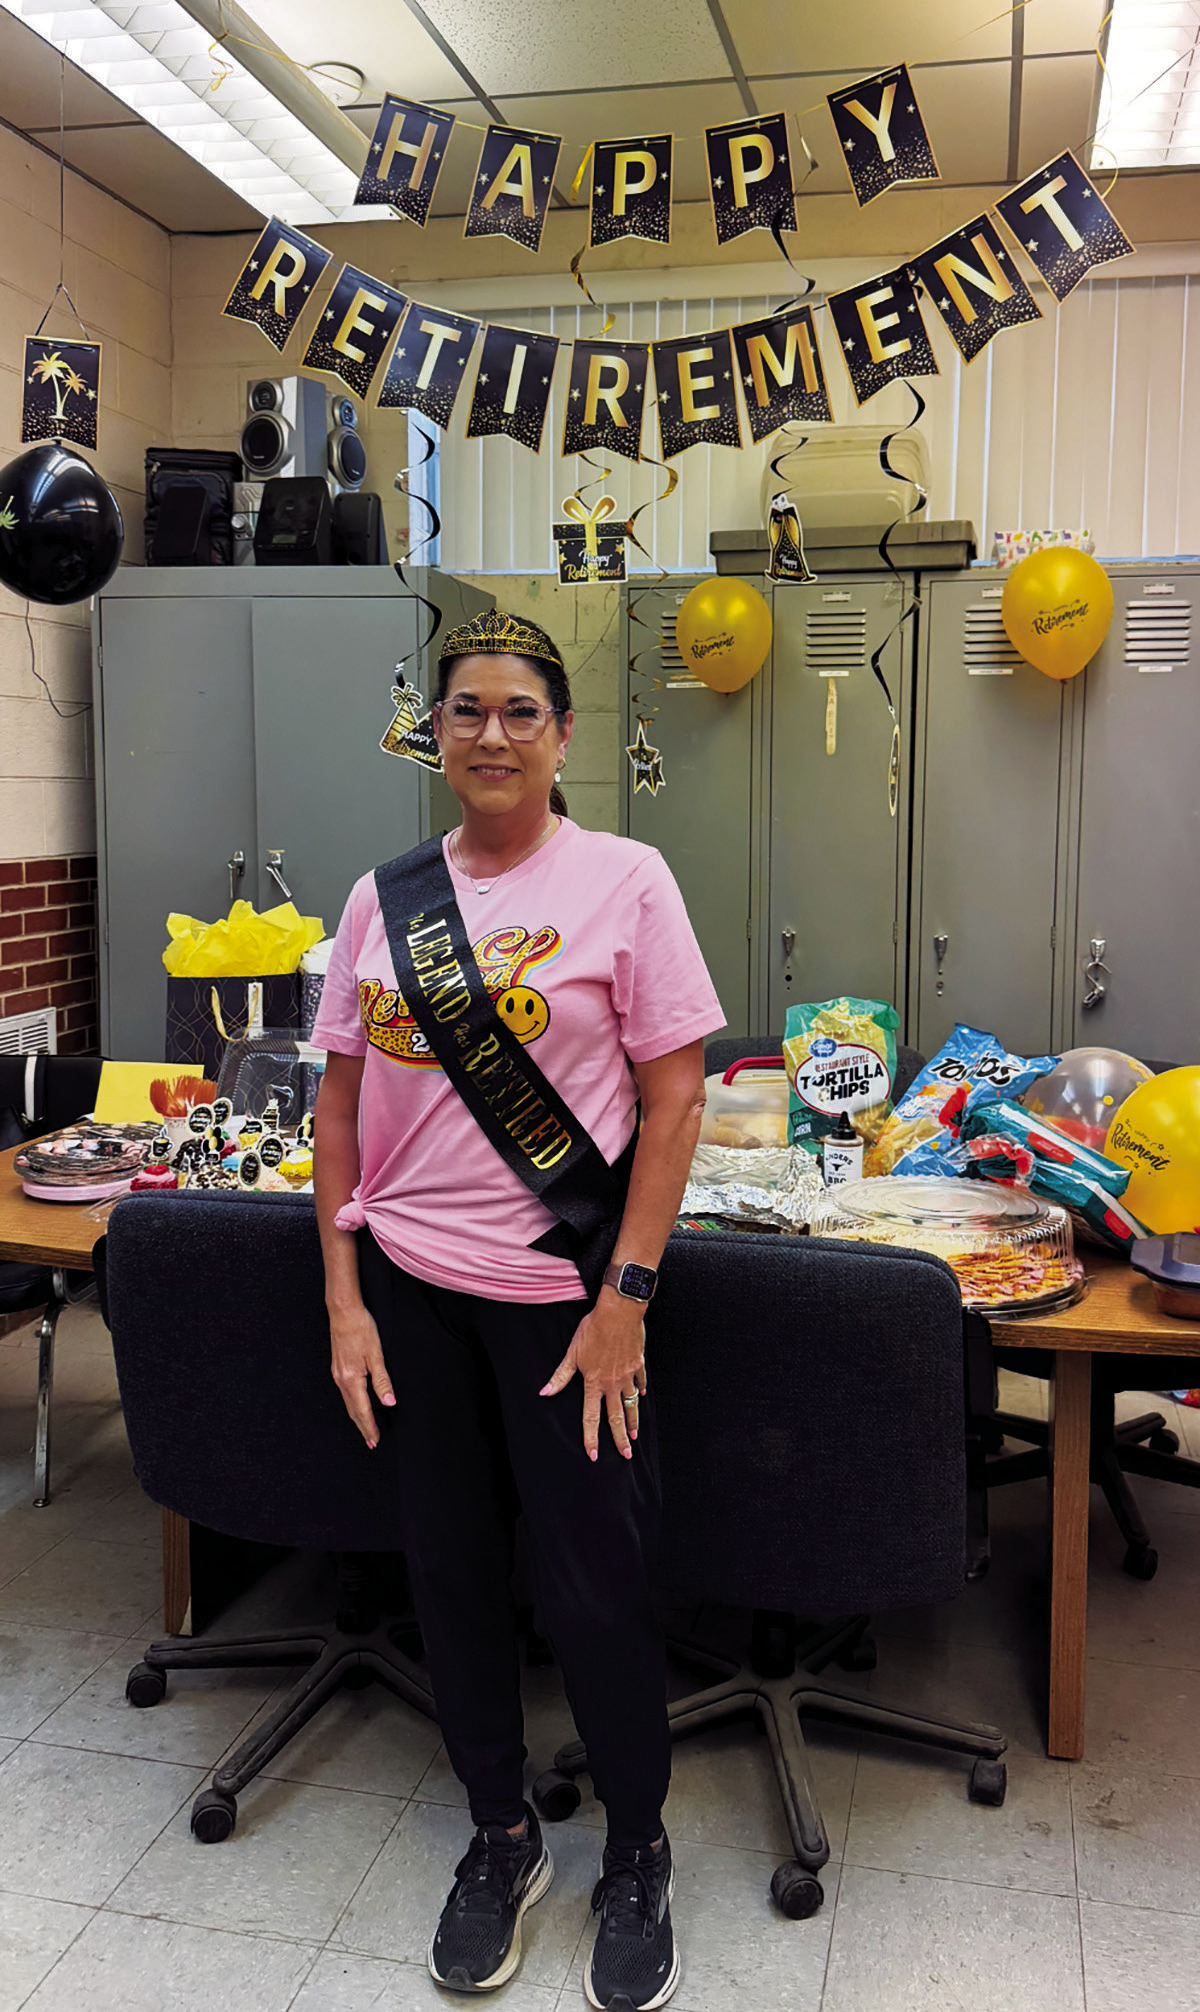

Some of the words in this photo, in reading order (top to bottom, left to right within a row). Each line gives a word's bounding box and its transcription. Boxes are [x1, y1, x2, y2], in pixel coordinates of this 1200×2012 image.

[376, 84, 897, 219] HAPPY
[251, 174, 1088, 429] RETIREMENT
[563, 562, 623, 581] Retirement
[578, 550, 612, 566] Happy
[1031, 602, 1088, 635] Retirement
[400, 728, 433, 746] HAPPY
[406, 918, 471, 1023] LEGEND
[457, 1032, 572, 1170] RETIRED
[852, 1053, 870, 1066] STYLE
[800, 1062, 884, 1090] TORTILLA
[818, 1080, 870, 1103] CHIPS
[1111, 1122, 1170, 1171] Retirement
